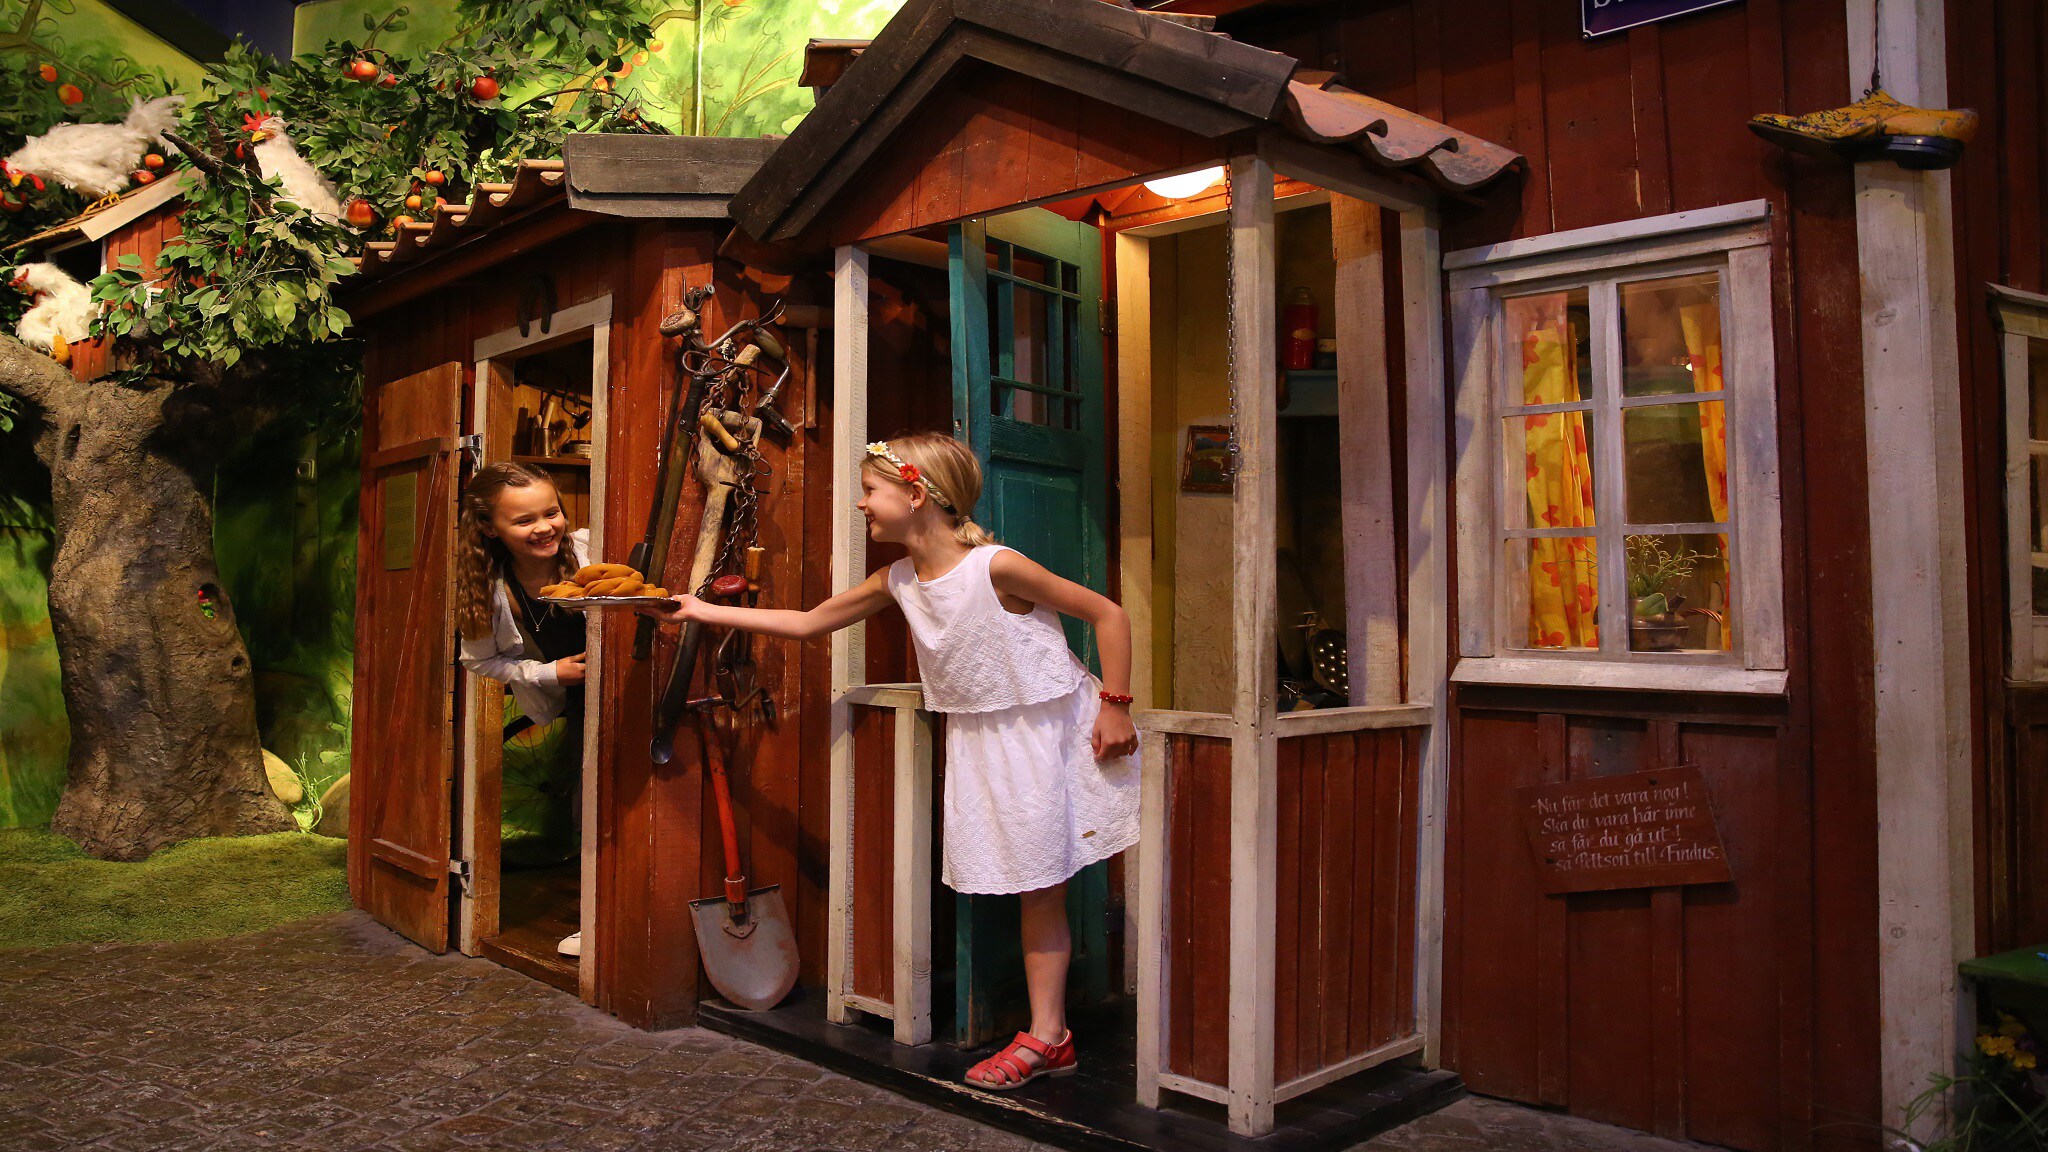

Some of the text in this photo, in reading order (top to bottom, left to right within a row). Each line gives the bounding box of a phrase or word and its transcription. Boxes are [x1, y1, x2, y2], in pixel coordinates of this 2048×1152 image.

[1590, 791, 1609, 809] det
[1615, 791, 1648, 805] vara
[1542, 806, 1696, 834] Ska du vara här inne
[1600, 829, 1619, 847] du
[1624, 827, 1643, 852] gå
[1634, 846, 1656, 865] till
